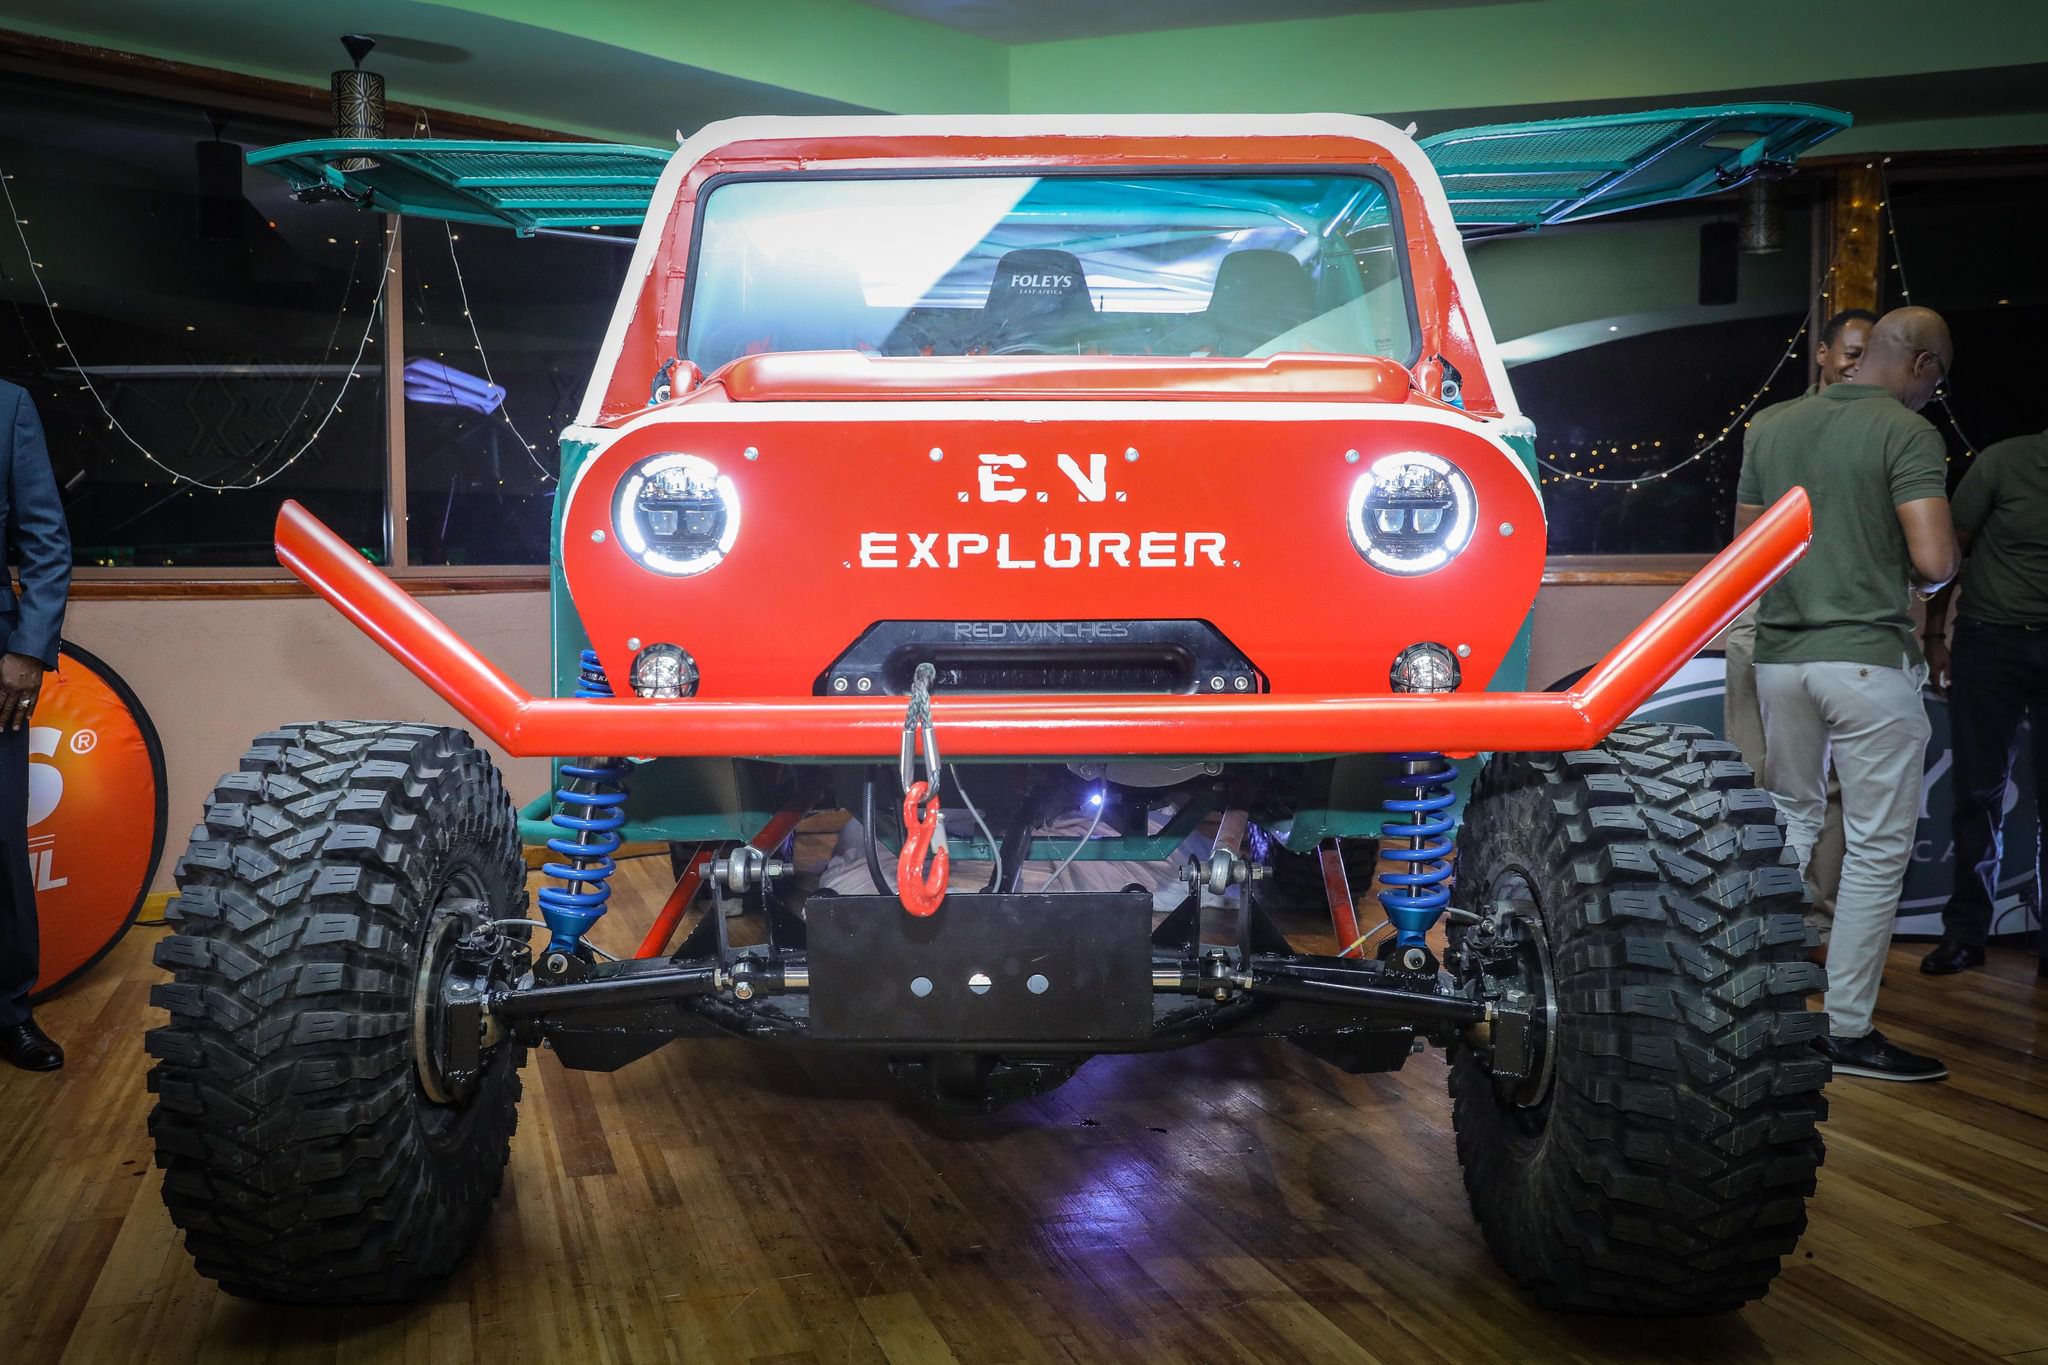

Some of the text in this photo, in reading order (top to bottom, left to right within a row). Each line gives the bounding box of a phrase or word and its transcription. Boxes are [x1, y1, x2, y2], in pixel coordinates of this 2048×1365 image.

[1011, 274, 1073, 288] FOLEYS
[954, 621, 1129, 640] RED WINCHES
